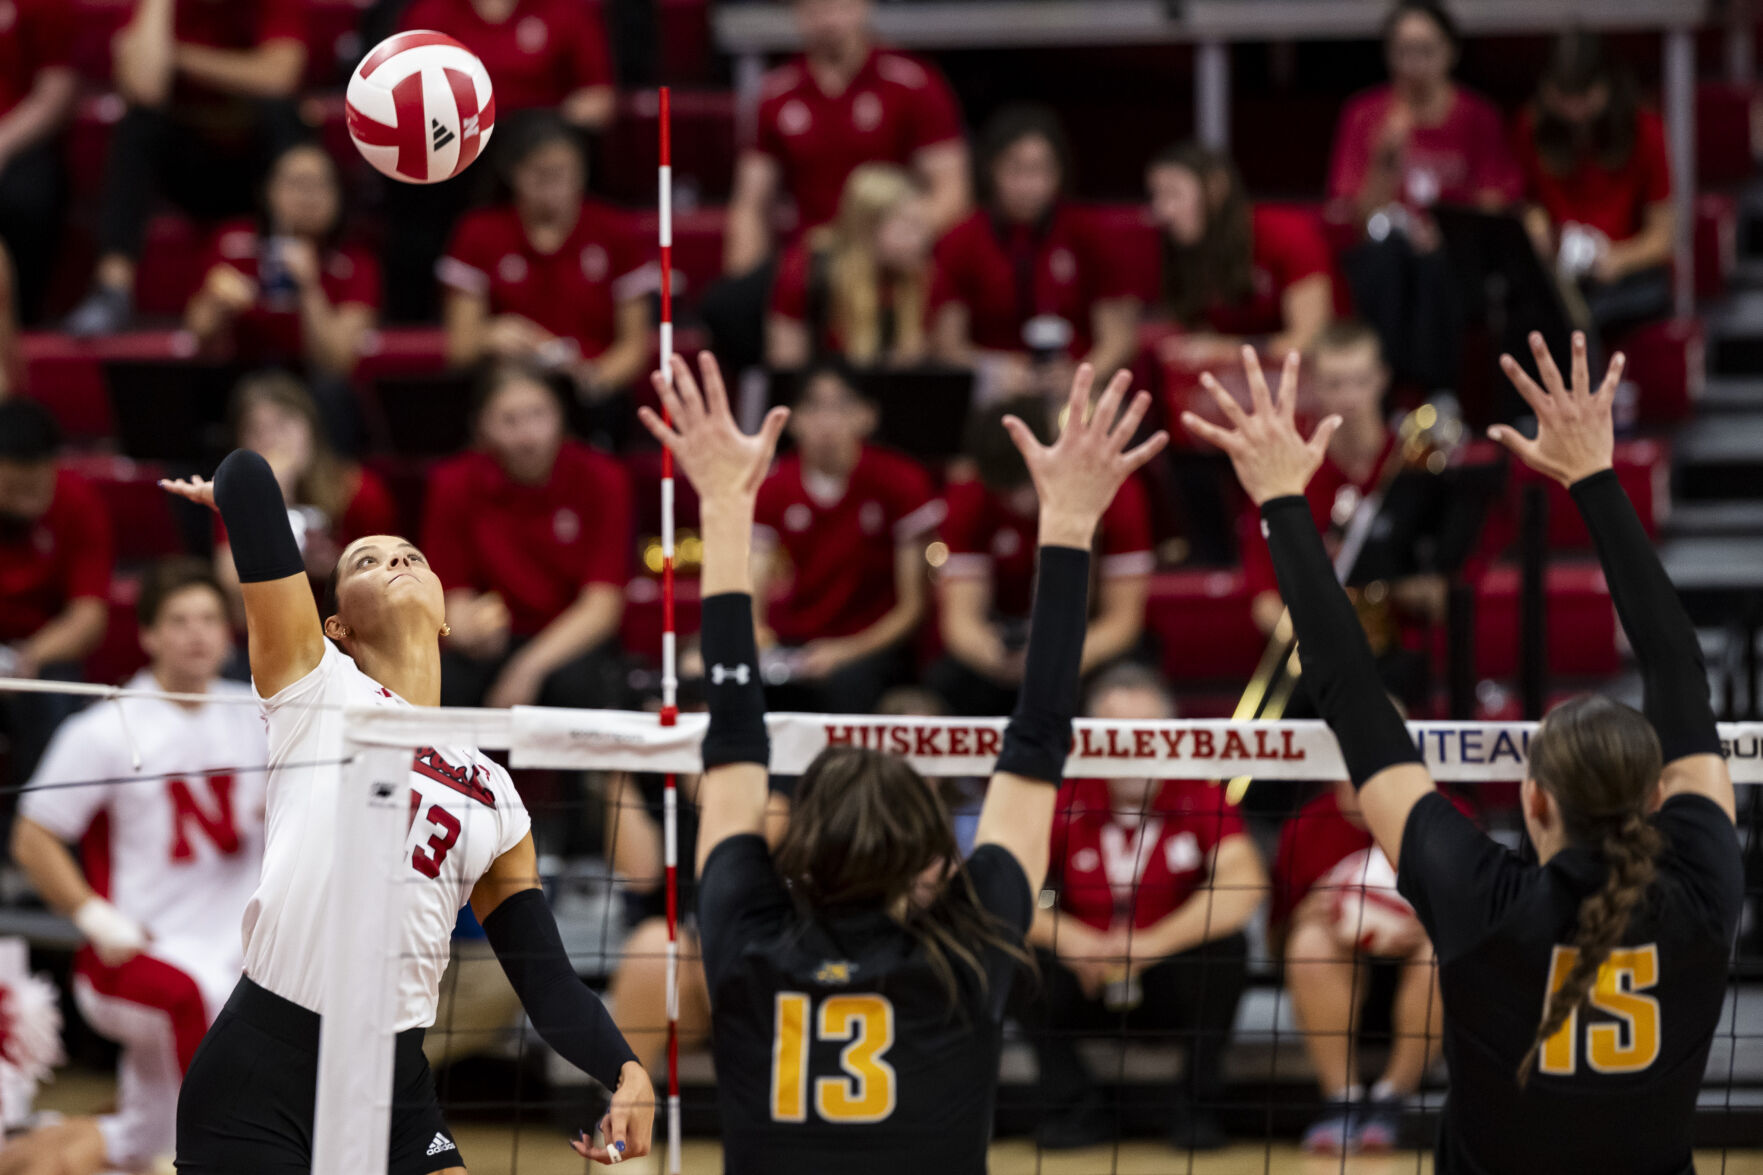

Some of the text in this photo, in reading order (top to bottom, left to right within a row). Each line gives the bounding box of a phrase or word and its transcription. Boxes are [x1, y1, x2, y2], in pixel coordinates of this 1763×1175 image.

[1068, 729, 1306, 760] LLEYBALL
[165, 767, 243, 863] N
[770, 992, 896, 1123] 13
[1539, 943, 1661, 1075] 15
